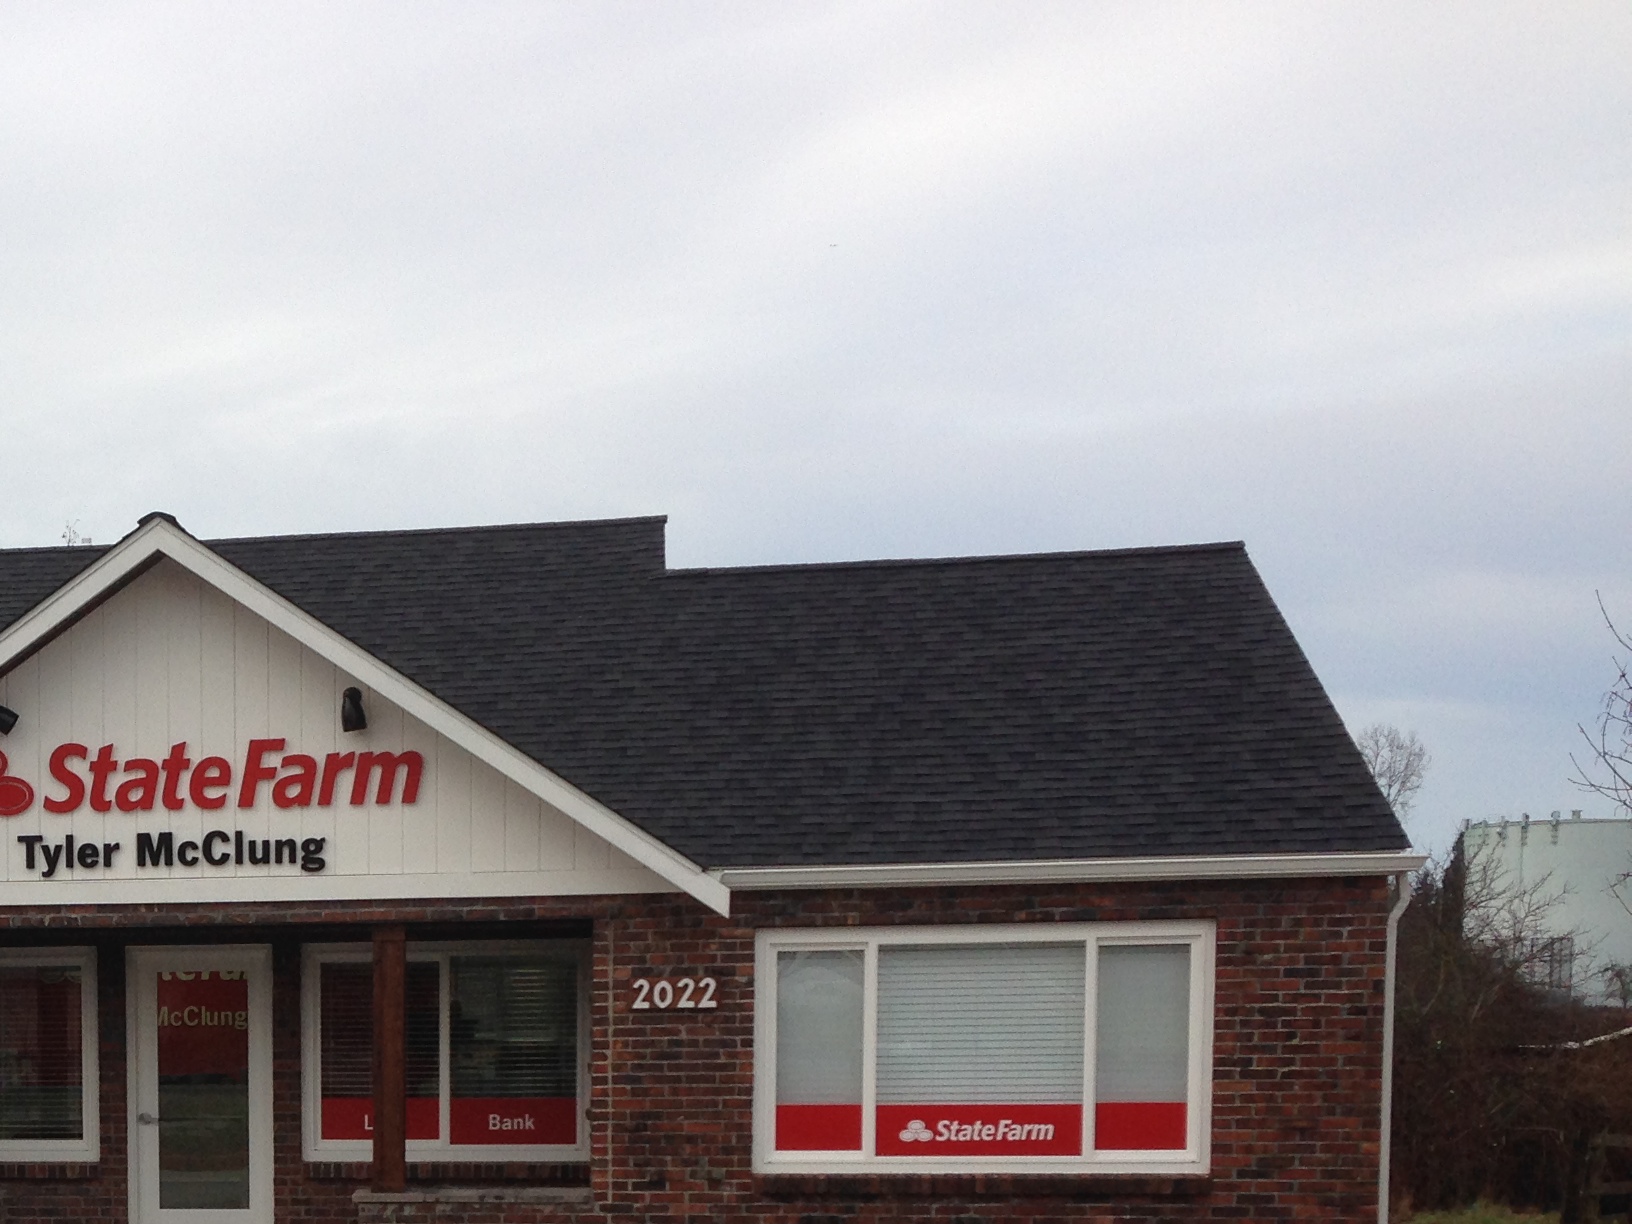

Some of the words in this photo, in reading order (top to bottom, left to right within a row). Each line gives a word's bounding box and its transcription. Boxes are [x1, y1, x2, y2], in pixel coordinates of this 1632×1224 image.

[17, 834, 120, 878] Tyler
[136, 830, 326, 873] McClung
[631, 977, 717, 1009] 2022
[488, 1113, 535, 1131] Bank
